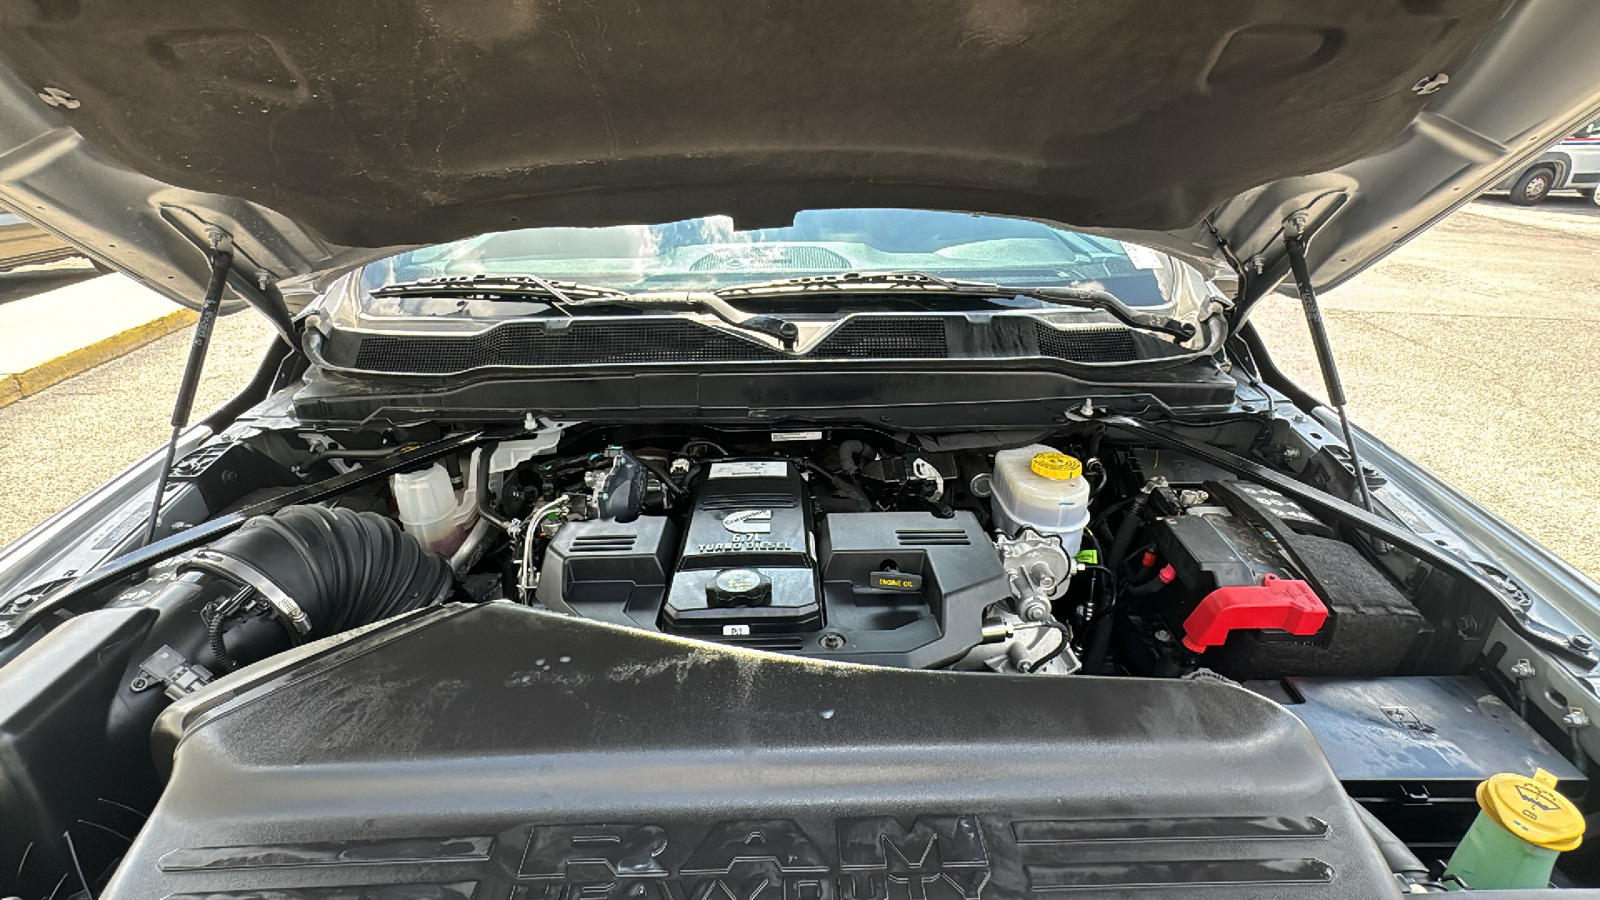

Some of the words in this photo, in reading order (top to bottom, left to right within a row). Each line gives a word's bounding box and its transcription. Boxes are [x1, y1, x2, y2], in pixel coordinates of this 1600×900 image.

[732, 533, 762, 543] 6.7L
[698, 542, 742, 552] TURBO
[746, 541, 791, 551] DIESEL
[878, 578, 902, 587] ENGINE
[902, 579, 914, 588] OIL
[517, 814, 991, 878] RAM
